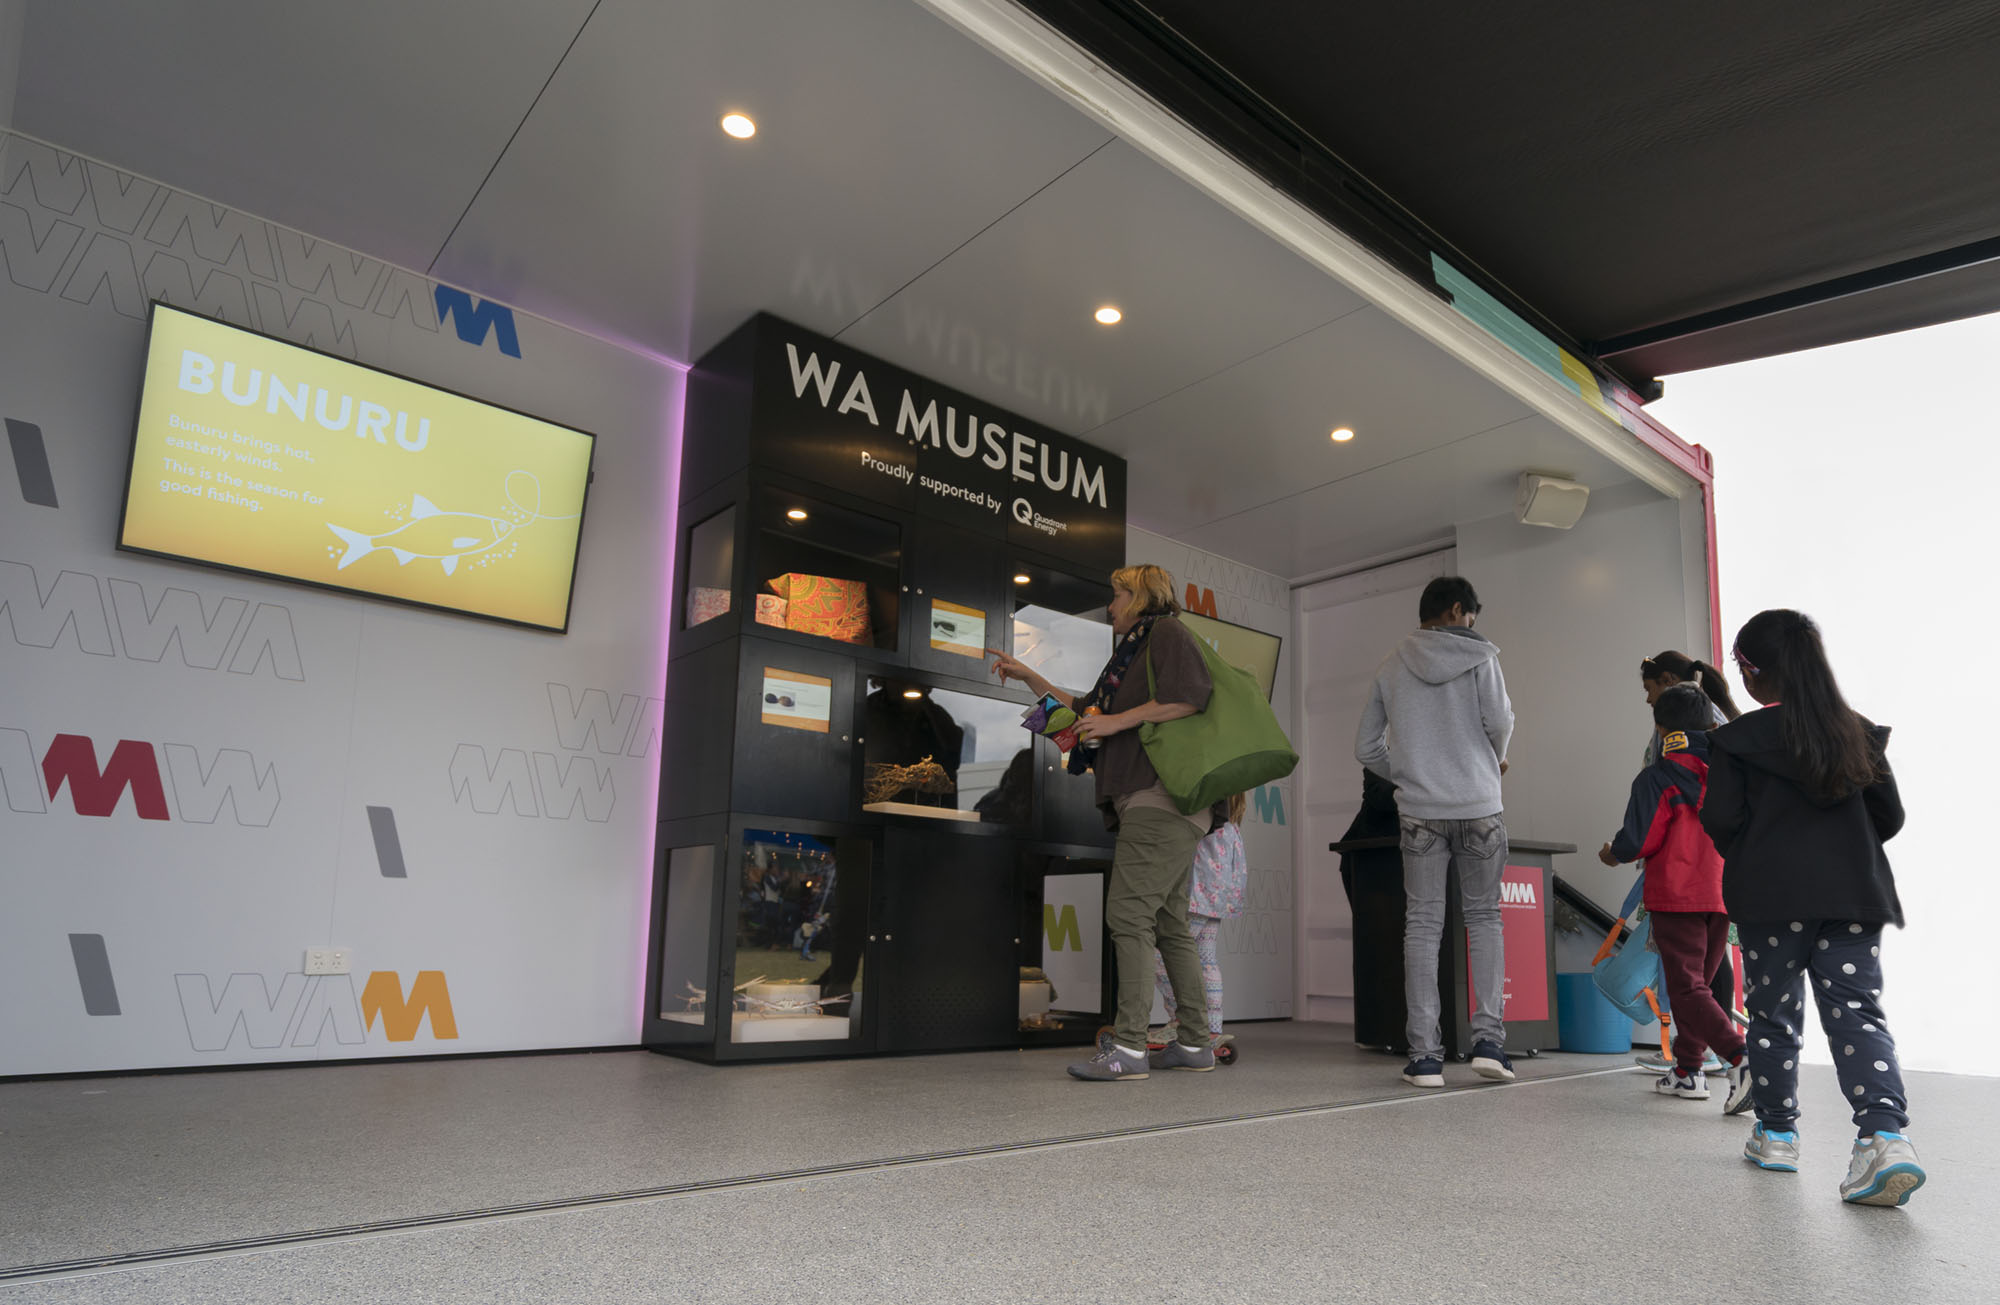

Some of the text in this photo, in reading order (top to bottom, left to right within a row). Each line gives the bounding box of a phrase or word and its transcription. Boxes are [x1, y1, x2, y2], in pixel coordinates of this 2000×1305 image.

[178, 349, 431, 452] BUNURU
[168, 413, 316, 464] Bunuru brings hot,
[786, 342, 1107, 509] WA MUSEUM
[165, 435, 283, 473] easterly winds.
[160, 478, 264, 512] good fishing.
[163, 457, 325, 505] This is the season for
[861, 451, 1002, 515] Proudly supported by
[1033, 512, 1067, 531] Quadrant
[1033, 520, 1058, 536] Energy
